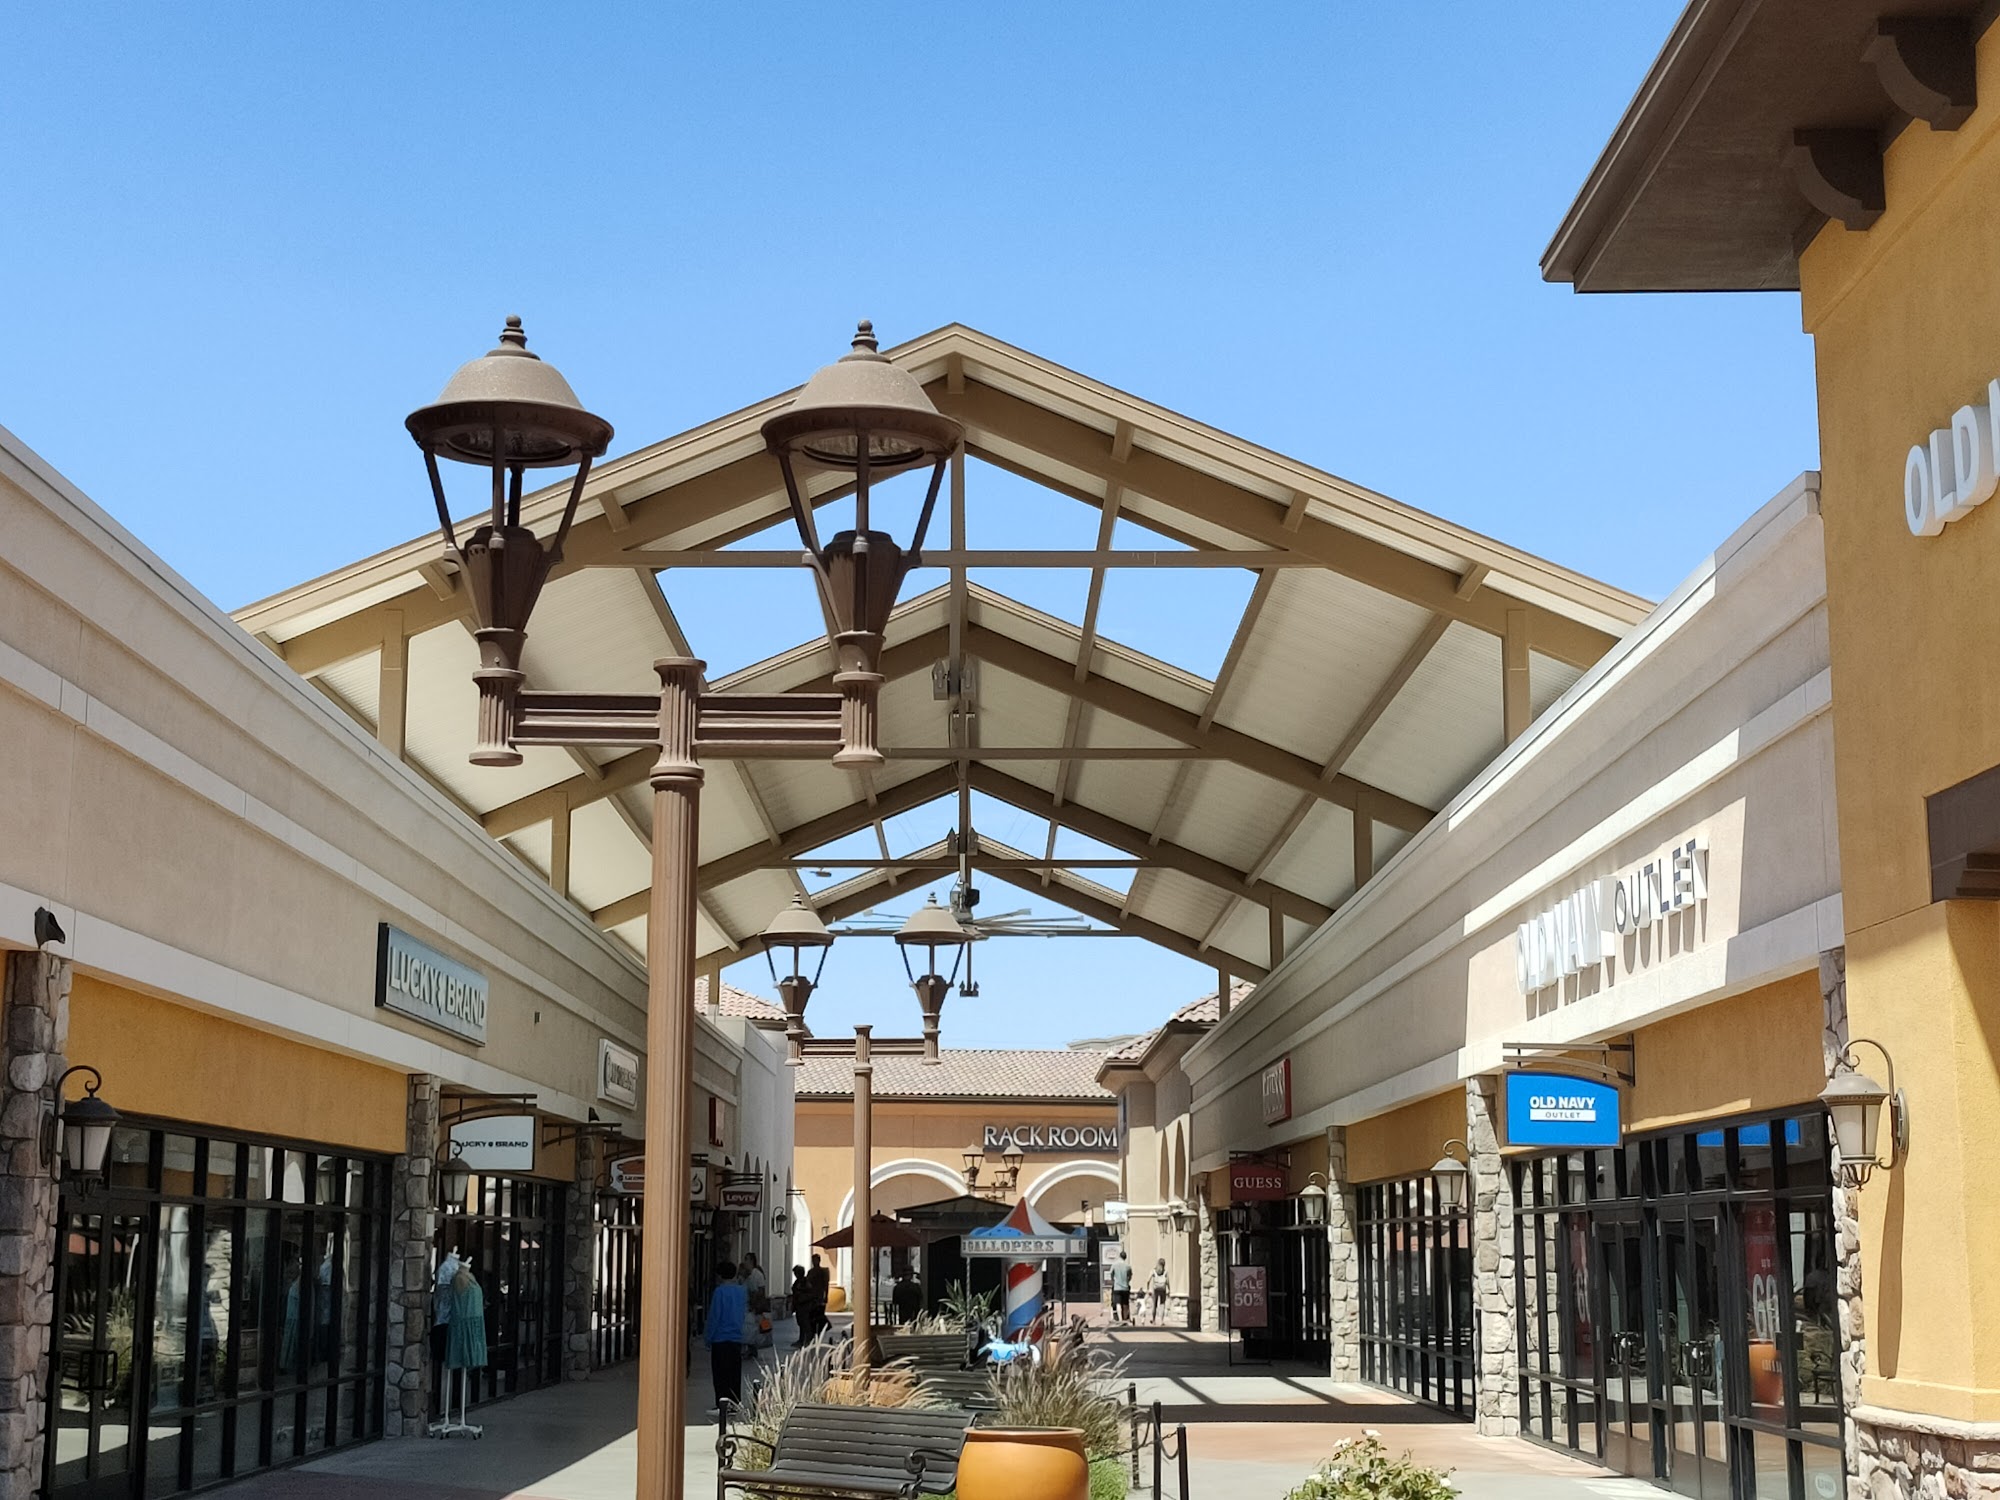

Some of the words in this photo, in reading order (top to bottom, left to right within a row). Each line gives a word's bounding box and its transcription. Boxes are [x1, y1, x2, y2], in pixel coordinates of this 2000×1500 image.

[1904, 404, 1998, 537] OLD
[1614, 837, 1709, 935] OUTLET
[390, 946, 439, 1006] LUCKY
[446, 974, 486, 1030] BRAND
[1529, 1095, 1557, 1109] OLD
[1558, 1096, 1596, 1109] NAVY
[1545, 1111, 1581, 1119] OUTLET
[984, 1125, 1044, 1147] RACK
[1047, 1126, 1118, 1147] ROOM
[495, 1140, 529, 1148] BRAND
[1233, 1176, 1282, 1189] GUESS
[967, 1240, 1054, 1253] GALLOPERS
[1234, 1279, 1264, 1290] SALE
